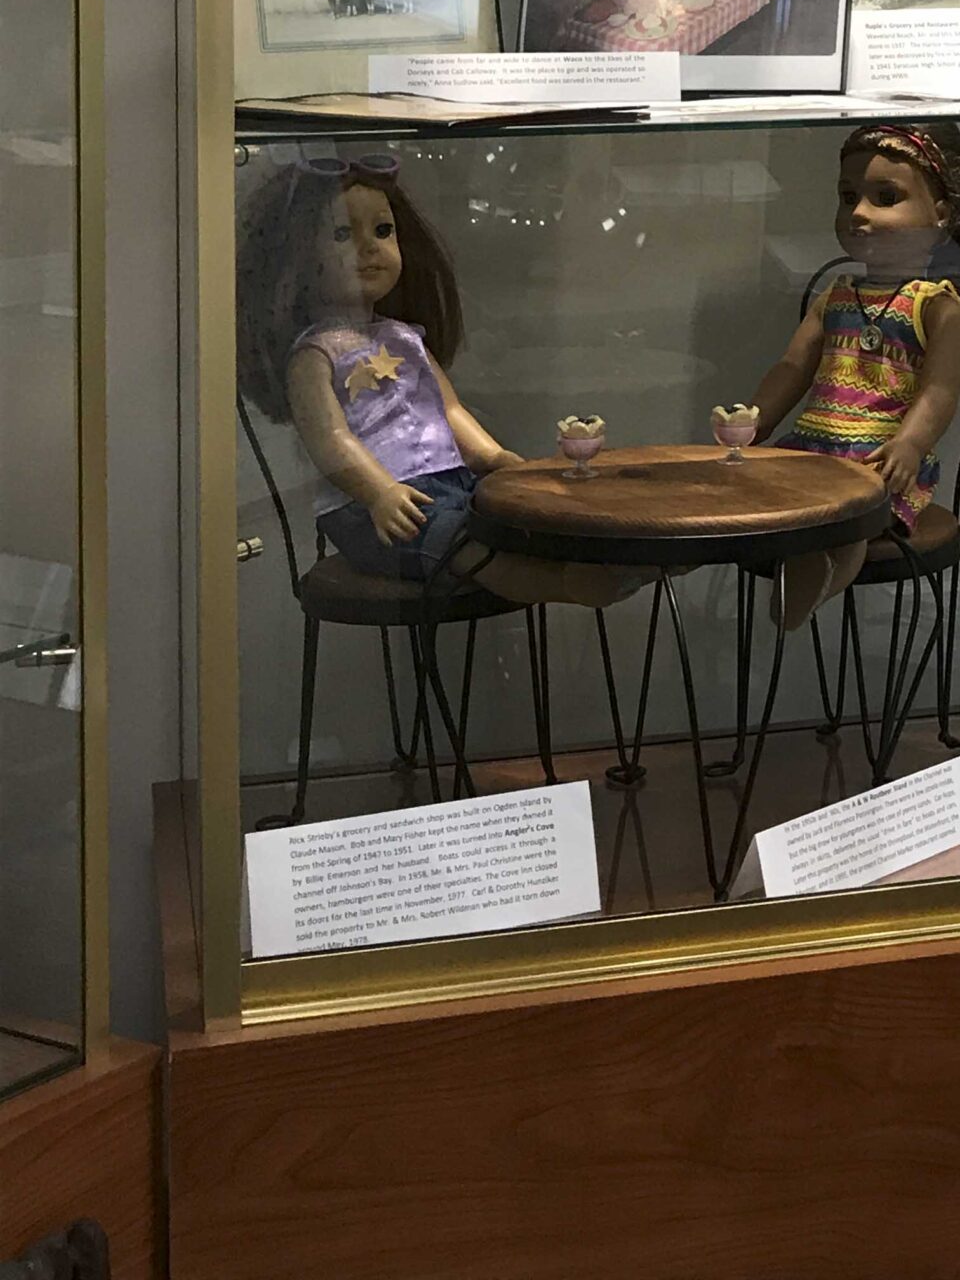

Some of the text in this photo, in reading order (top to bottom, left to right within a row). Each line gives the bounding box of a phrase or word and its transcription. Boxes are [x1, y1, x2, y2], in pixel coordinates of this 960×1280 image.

[289, 847, 316, 858] Claude
[350, 839, 365, 848] Bob
[367, 836, 381, 846] and
[383, 833, 402, 845] Mary
[404, 829, 426, 840] Fisher
[427, 826, 444, 837] kept
[445, 824, 458, 833] the
[459, 822, 481, 830] name
[481, 817, 502, 827] when
[503, 814, 520, 825] they
[520, 810, 546, 820] owned
[547, 808, 553, 816] it
[342, 826, 371, 838] grocery
[373, 822, 387, 831] and
[389, 816, 425, 828] sandwich
[425, 813, 444, 824] shop
[446, 812, 461, 820] was
[462, 807, 479, 817] built
[492, 801, 518, 814] Ogden
[519, 797, 541, 808] Island
[542, 796, 552, 806] by
[290, 862, 310, 872] from
[311, 859, 325, 869] the
[326, 855, 351, 868] Spring
[352, 853, 361, 862] of
[382, 848, 392, 857] to
[417, 841, 436, 851] Later
[438, 839, 444, 848] it
[445, 839, 460, 847] was
[461, 833, 486, 844] turned
[487, 830, 503, 840] into
[504, 825, 535, 838] Angler's
[535, 821, 554, 832] Cove
[291, 877, 302, 887] by
[326, 868, 361, 880] Emerson
[363, 865, 378, 874] and
[381, 862, 394, 871] her
[438, 852, 459, 861] Boats
[461, 848, 481, 858] could
[484, 845, 508, 854] access
[518, 837, 548, 849] through
[292, 887, 324, 900] channel
[325, 885, 337, 894] off
[338, 879, 376, 892] Johnson's
[398, 874, 406, 882] In
[445, 866, 452, 874] &
[472, 860, 488, 869] Paul
[489, 855, 522, 866] Christine
[544, 849, 556, 857] the
[327, 893, 373, 909] hamburgers
[375, 891, 395, 899] were
[396, 888, 412, 896] one
[413, 884, 422, 893] of
[423, 881, 441, 891] their
[485, 871, 498, 880] The
[500, 868, 519, 878] Cove
[520, 866, 532, 874] Inn
[534, 861, 558, 872] closed
